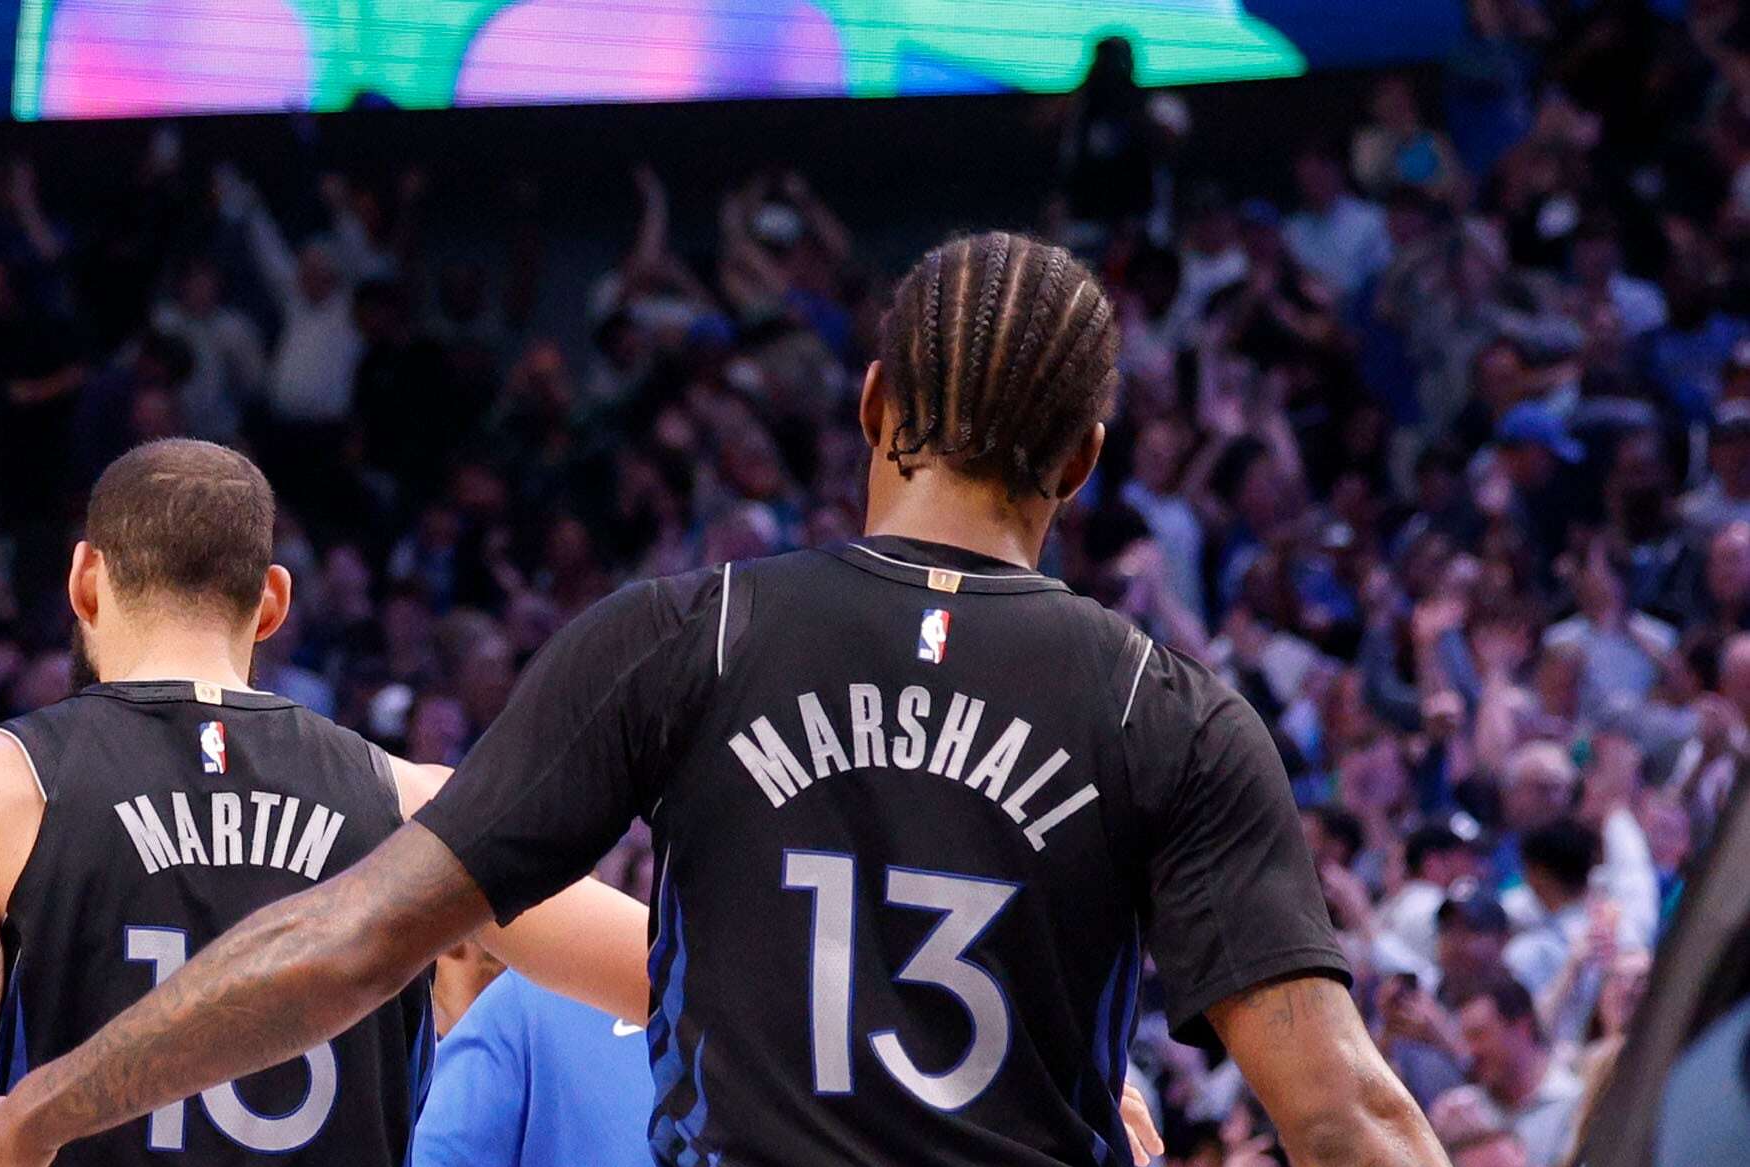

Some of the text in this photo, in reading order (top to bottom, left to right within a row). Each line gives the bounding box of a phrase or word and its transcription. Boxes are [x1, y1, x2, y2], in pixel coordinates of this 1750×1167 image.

[113, 790, 346, 881] MARTIN
[728, 683, 1100, 852] MARSHALL
[780, 848, 1025, 1115] 13
